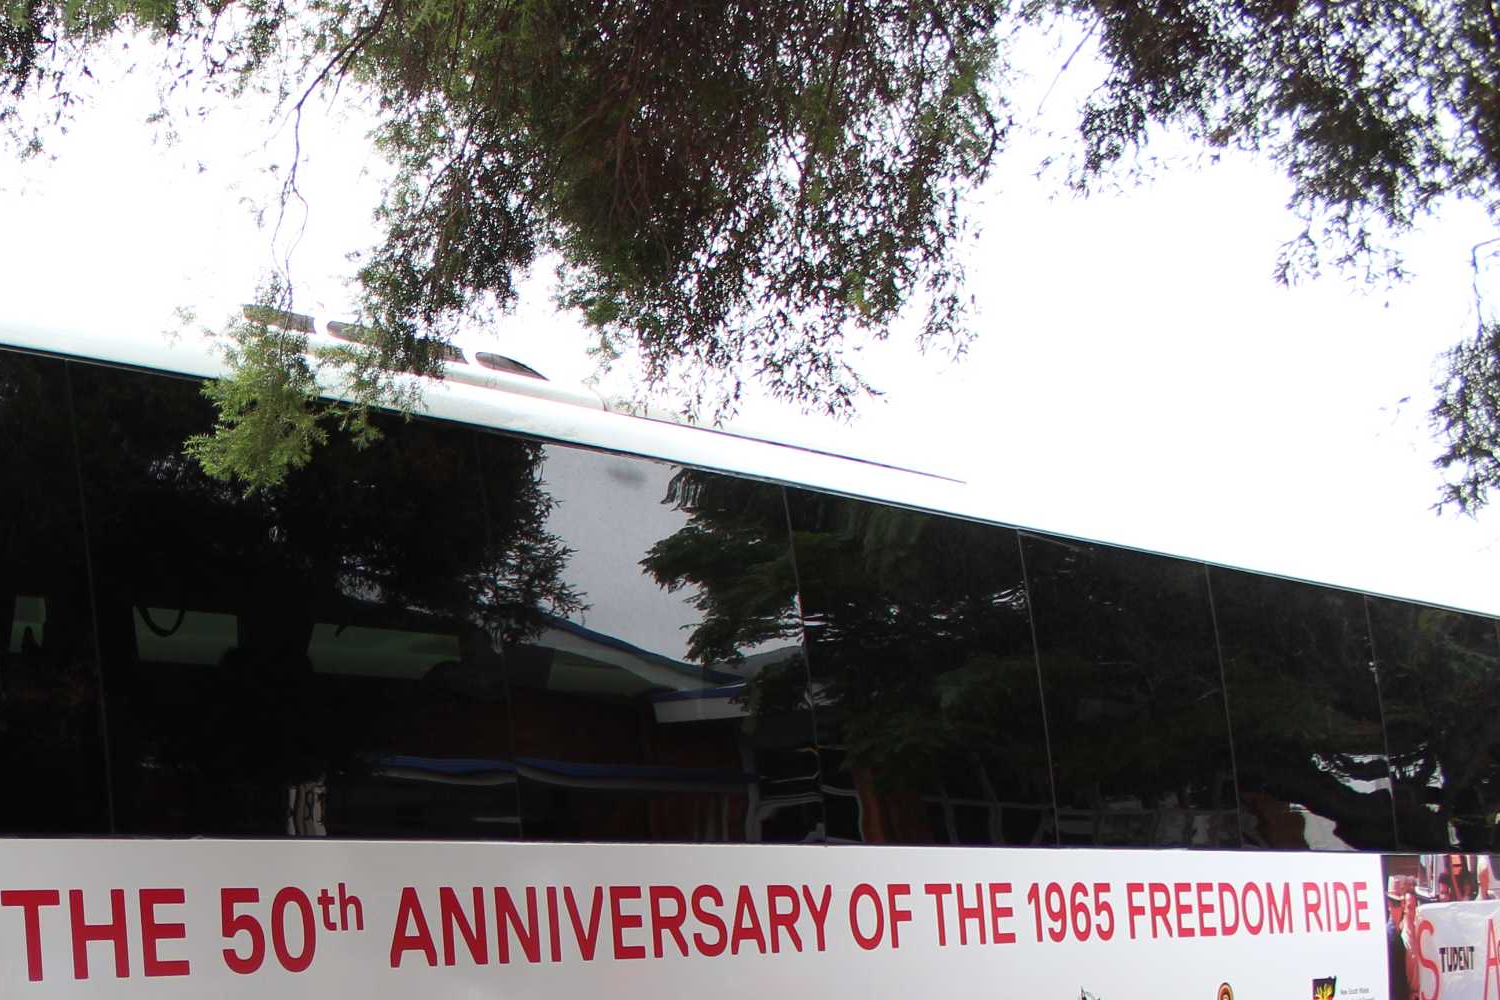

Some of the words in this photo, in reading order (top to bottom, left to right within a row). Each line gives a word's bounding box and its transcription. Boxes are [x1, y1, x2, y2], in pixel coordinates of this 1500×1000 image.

[0, 889, 191, 982] THE
[221, 883, 365, 973] 50th
[390, 885, 833, 968] ANNIVERSARY
[849, 883, 913, 950] OF
[924, 883, 1016, 946] THE
[1027, 882, 1116, 943] 1965
[1126, 882, 1294, 939] FREEDOM
[1302, 881, 1371, 933] RIDE
